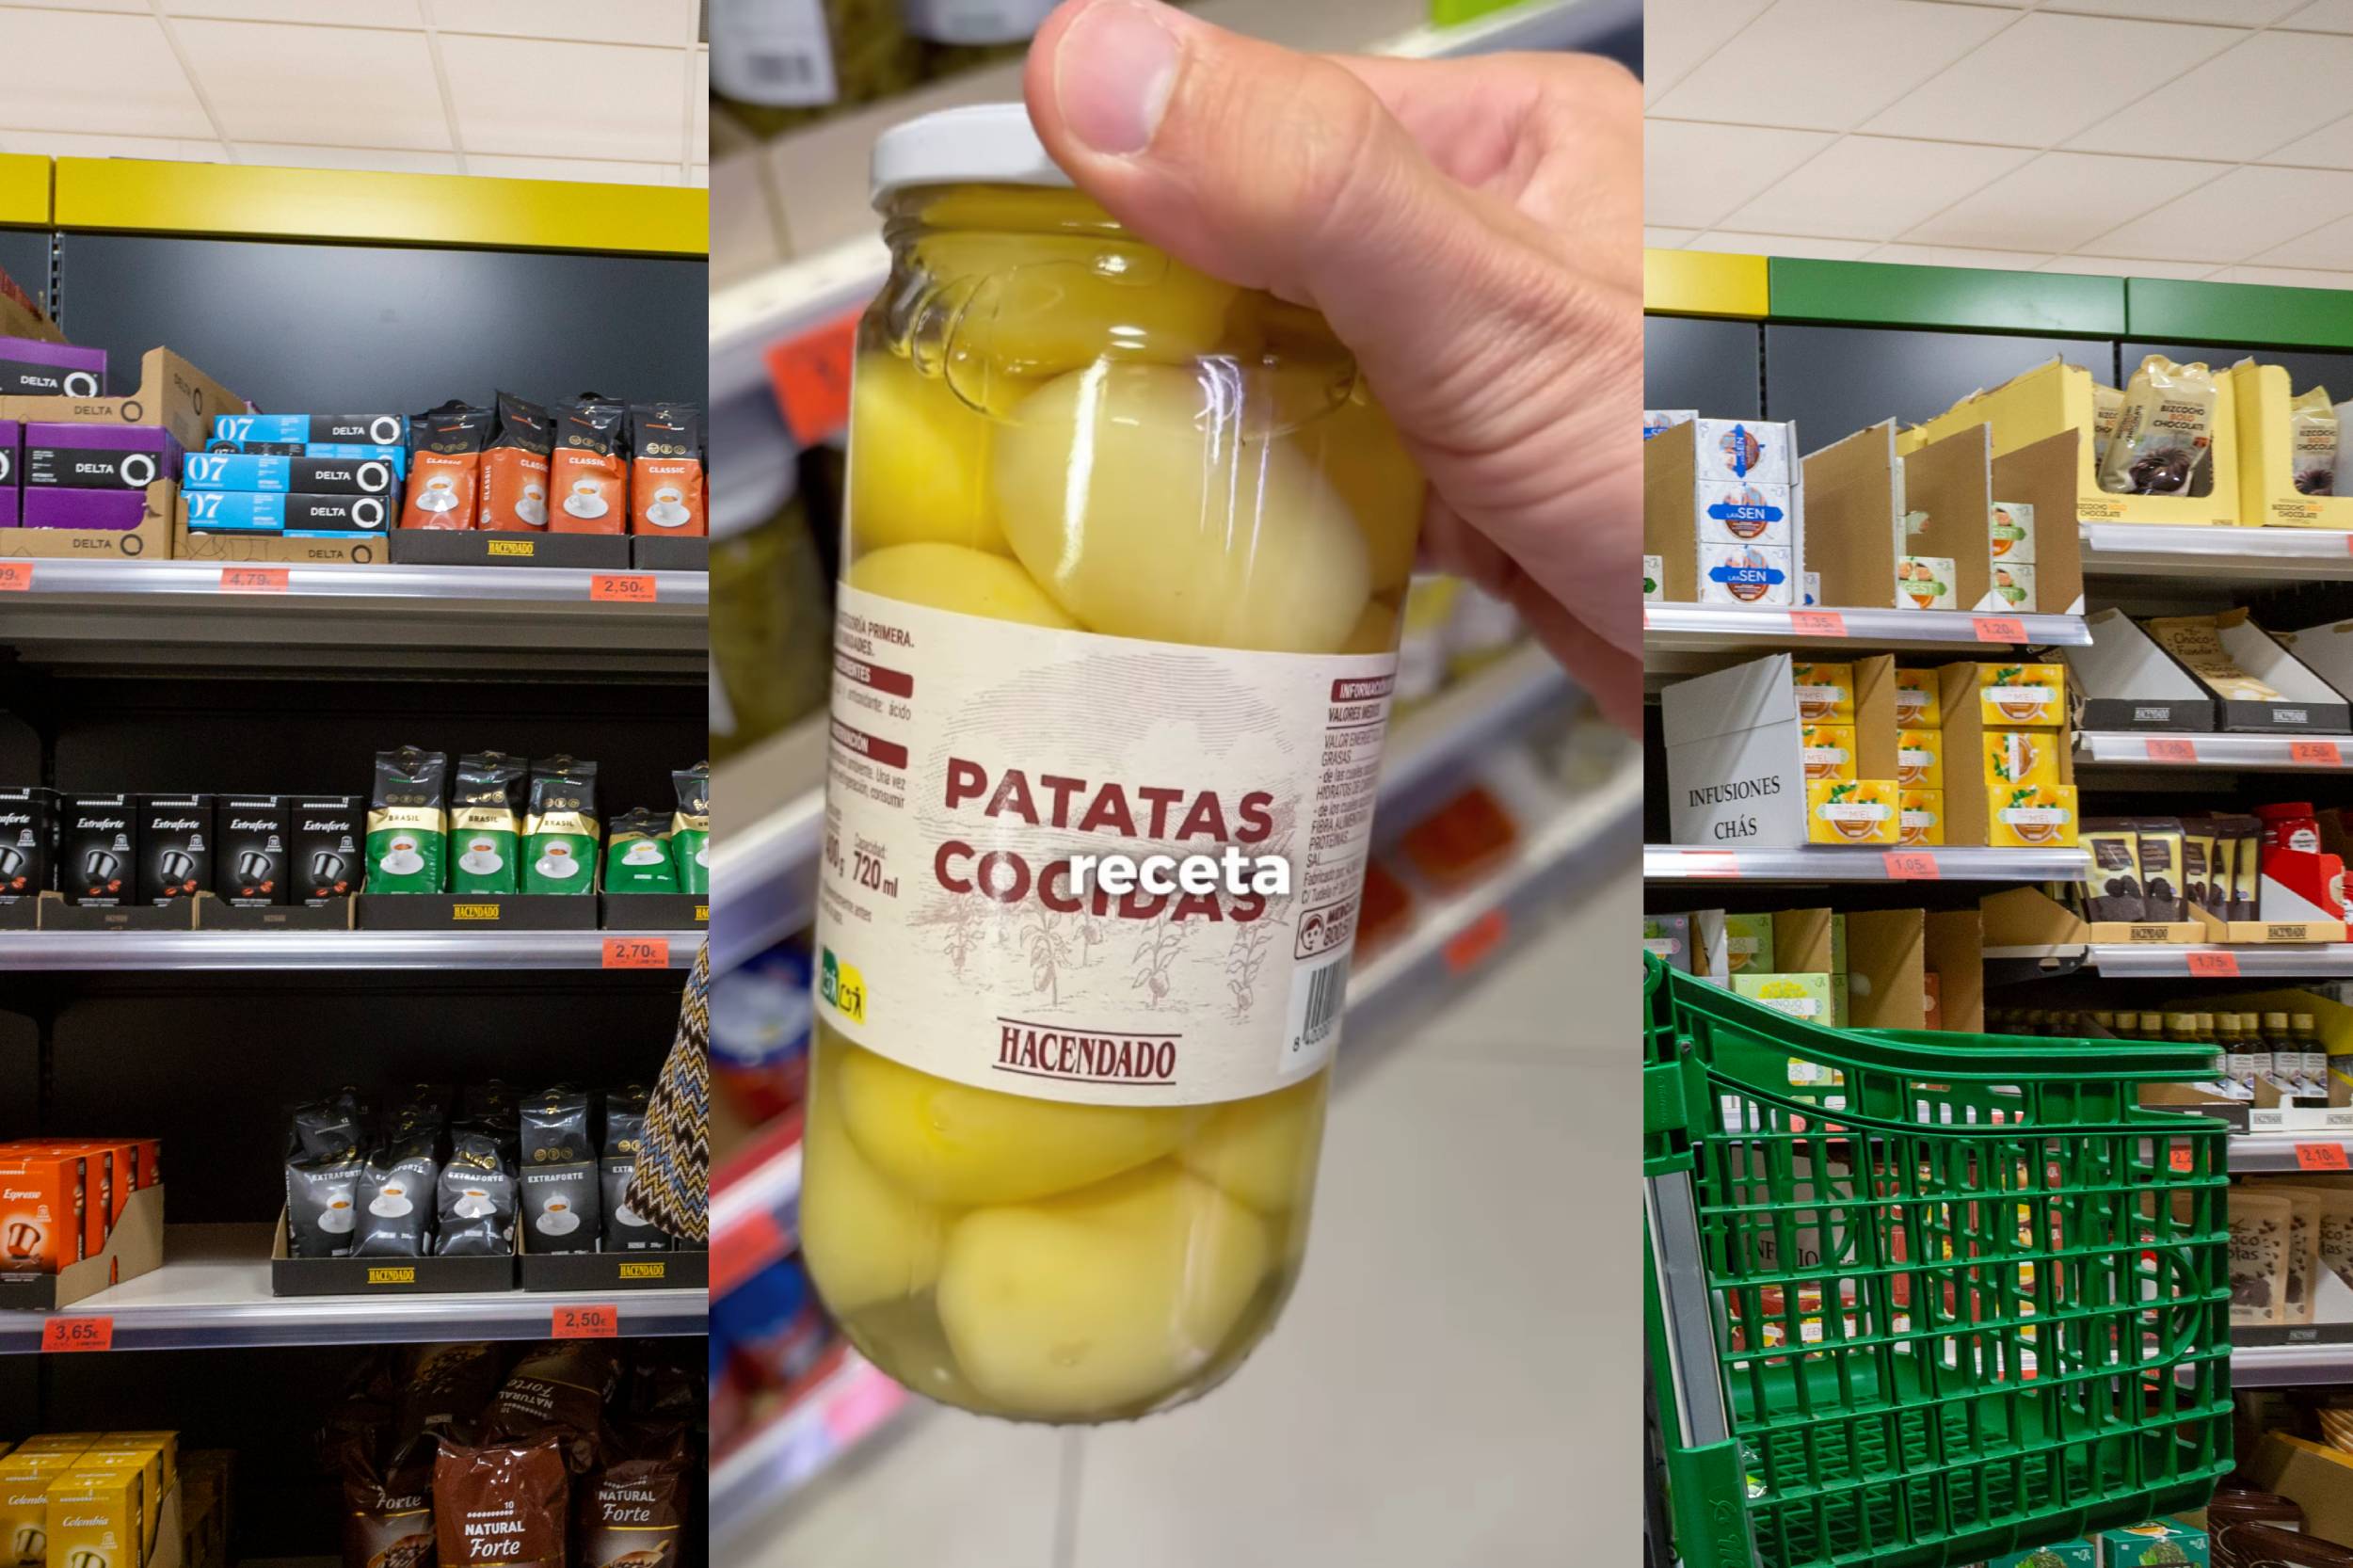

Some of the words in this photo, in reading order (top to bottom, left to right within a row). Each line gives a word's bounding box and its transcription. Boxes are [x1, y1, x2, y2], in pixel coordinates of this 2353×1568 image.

[20, 376, 57, 388] DELTA
[73, 405, 113, 416] DELTA
[2097, 411, 2118, 420] BIZC
[217, 418, 254, 442] 07
[332, 426, 365, 437] DELTA
[426, 457, 462, 466] CLASSIC
[568, 456, 606, 468] CLASSIC
[75, 463, 114, 475] DELTA
[188, 457, 229, 483] 07
[315, 471, 351, 482] DELTA
[648, 466, 685, 474] CLASSIC
[310, 507, 346, 518] DELTA
[72, 538, 113, 550] DELTA
[308, 550, 344, 560] DELTA
[869, 620, 914, 648] PRIMERA.
[888, 700, 911, 721] ácido
[1328, 707, 1361, 723] VALORES
[1688, 775, 1782, 808] INFUSIONES
[945, 757, 1274, 844] PATATAS
[76, 817, 126, 831] Extraforte
[152, 817, 200, 831] Extraforte
[230, 818, 279, 831] Extraforte
[388, 813, 421, 823] BRASIL
[468, 814, 499, 824] BRASIL
[544, 819, 576, 828] BRASIL
[302, 820, 350, 832] Extraforte
[1714, 814, 1757, 840] CHÁS
[853, 851, 882, 890] 720
[883, 877, 899, 899] ml
[934, 840, 1269, 922] COCIDAS
[453, 906, 500, 920] HACENDADO
[998, 1025, 1177, 1080] HACENDADO
[447, 1172, 504, 1183] EXTRAFORTE
[528, 1172, 584, 1184] EXTRAFORTE
[3, 1189, 41, 1201] Espresso
[369, 1268, 415, 1283] HACENDADO
[619, 1264, 665, 1278] HACENDADO
[55, 1324, 99, 1342] 3,65€
[505, 1376, 553, 1399] Forte
[499, 1390, 553, 1409] NATURAL
[8, 1494, 47, 1506] Colombi
[376, 1490, 422, 1509] Forte
[599, 1489, 656, 1503] NATURAL
[504, 1500, 514, 1510] 10
[601, 1503, 651, 1522] Forte
[464, 1520, 526, 1537] NATURAL
[470, 1538, 521, 1560] Forte
